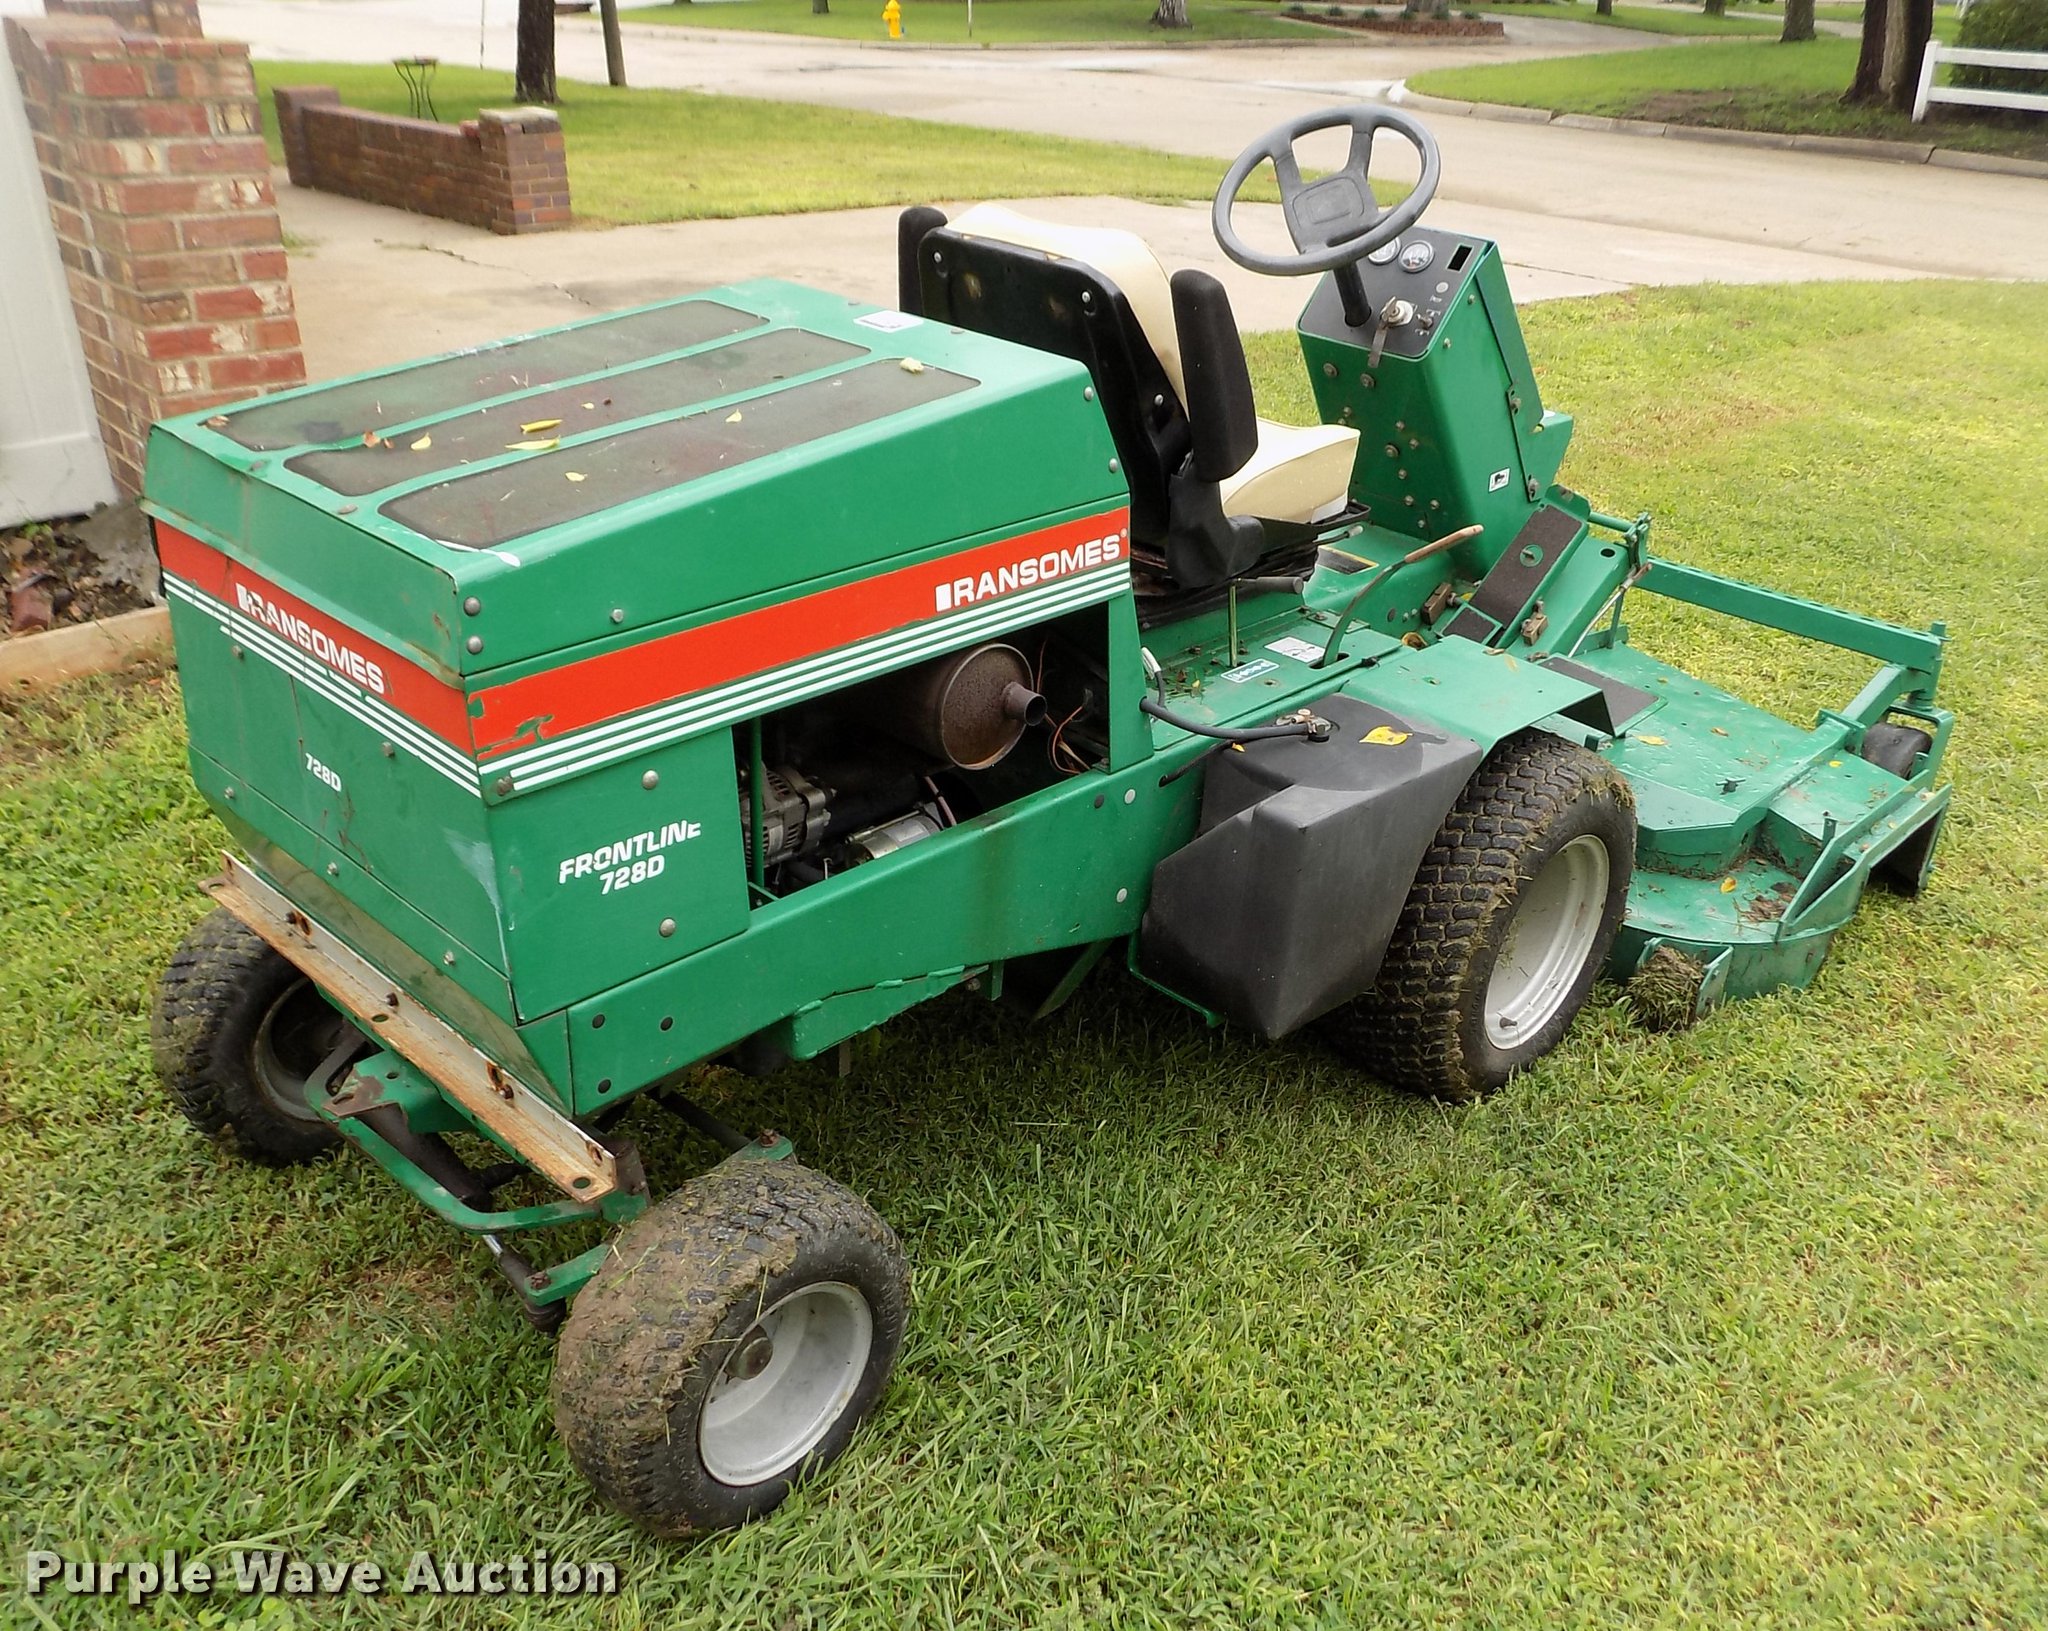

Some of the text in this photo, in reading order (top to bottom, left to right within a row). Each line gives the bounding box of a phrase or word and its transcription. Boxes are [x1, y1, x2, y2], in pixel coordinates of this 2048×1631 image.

[952, 534, 1121, 608] RANSOMES
[247, 588, 386, 695] RANSOMES
[305, 752, 342, 793] 728D
[558, 819, 702, 885] FRONTLINE
[599, 854, 666, 896] 728D
